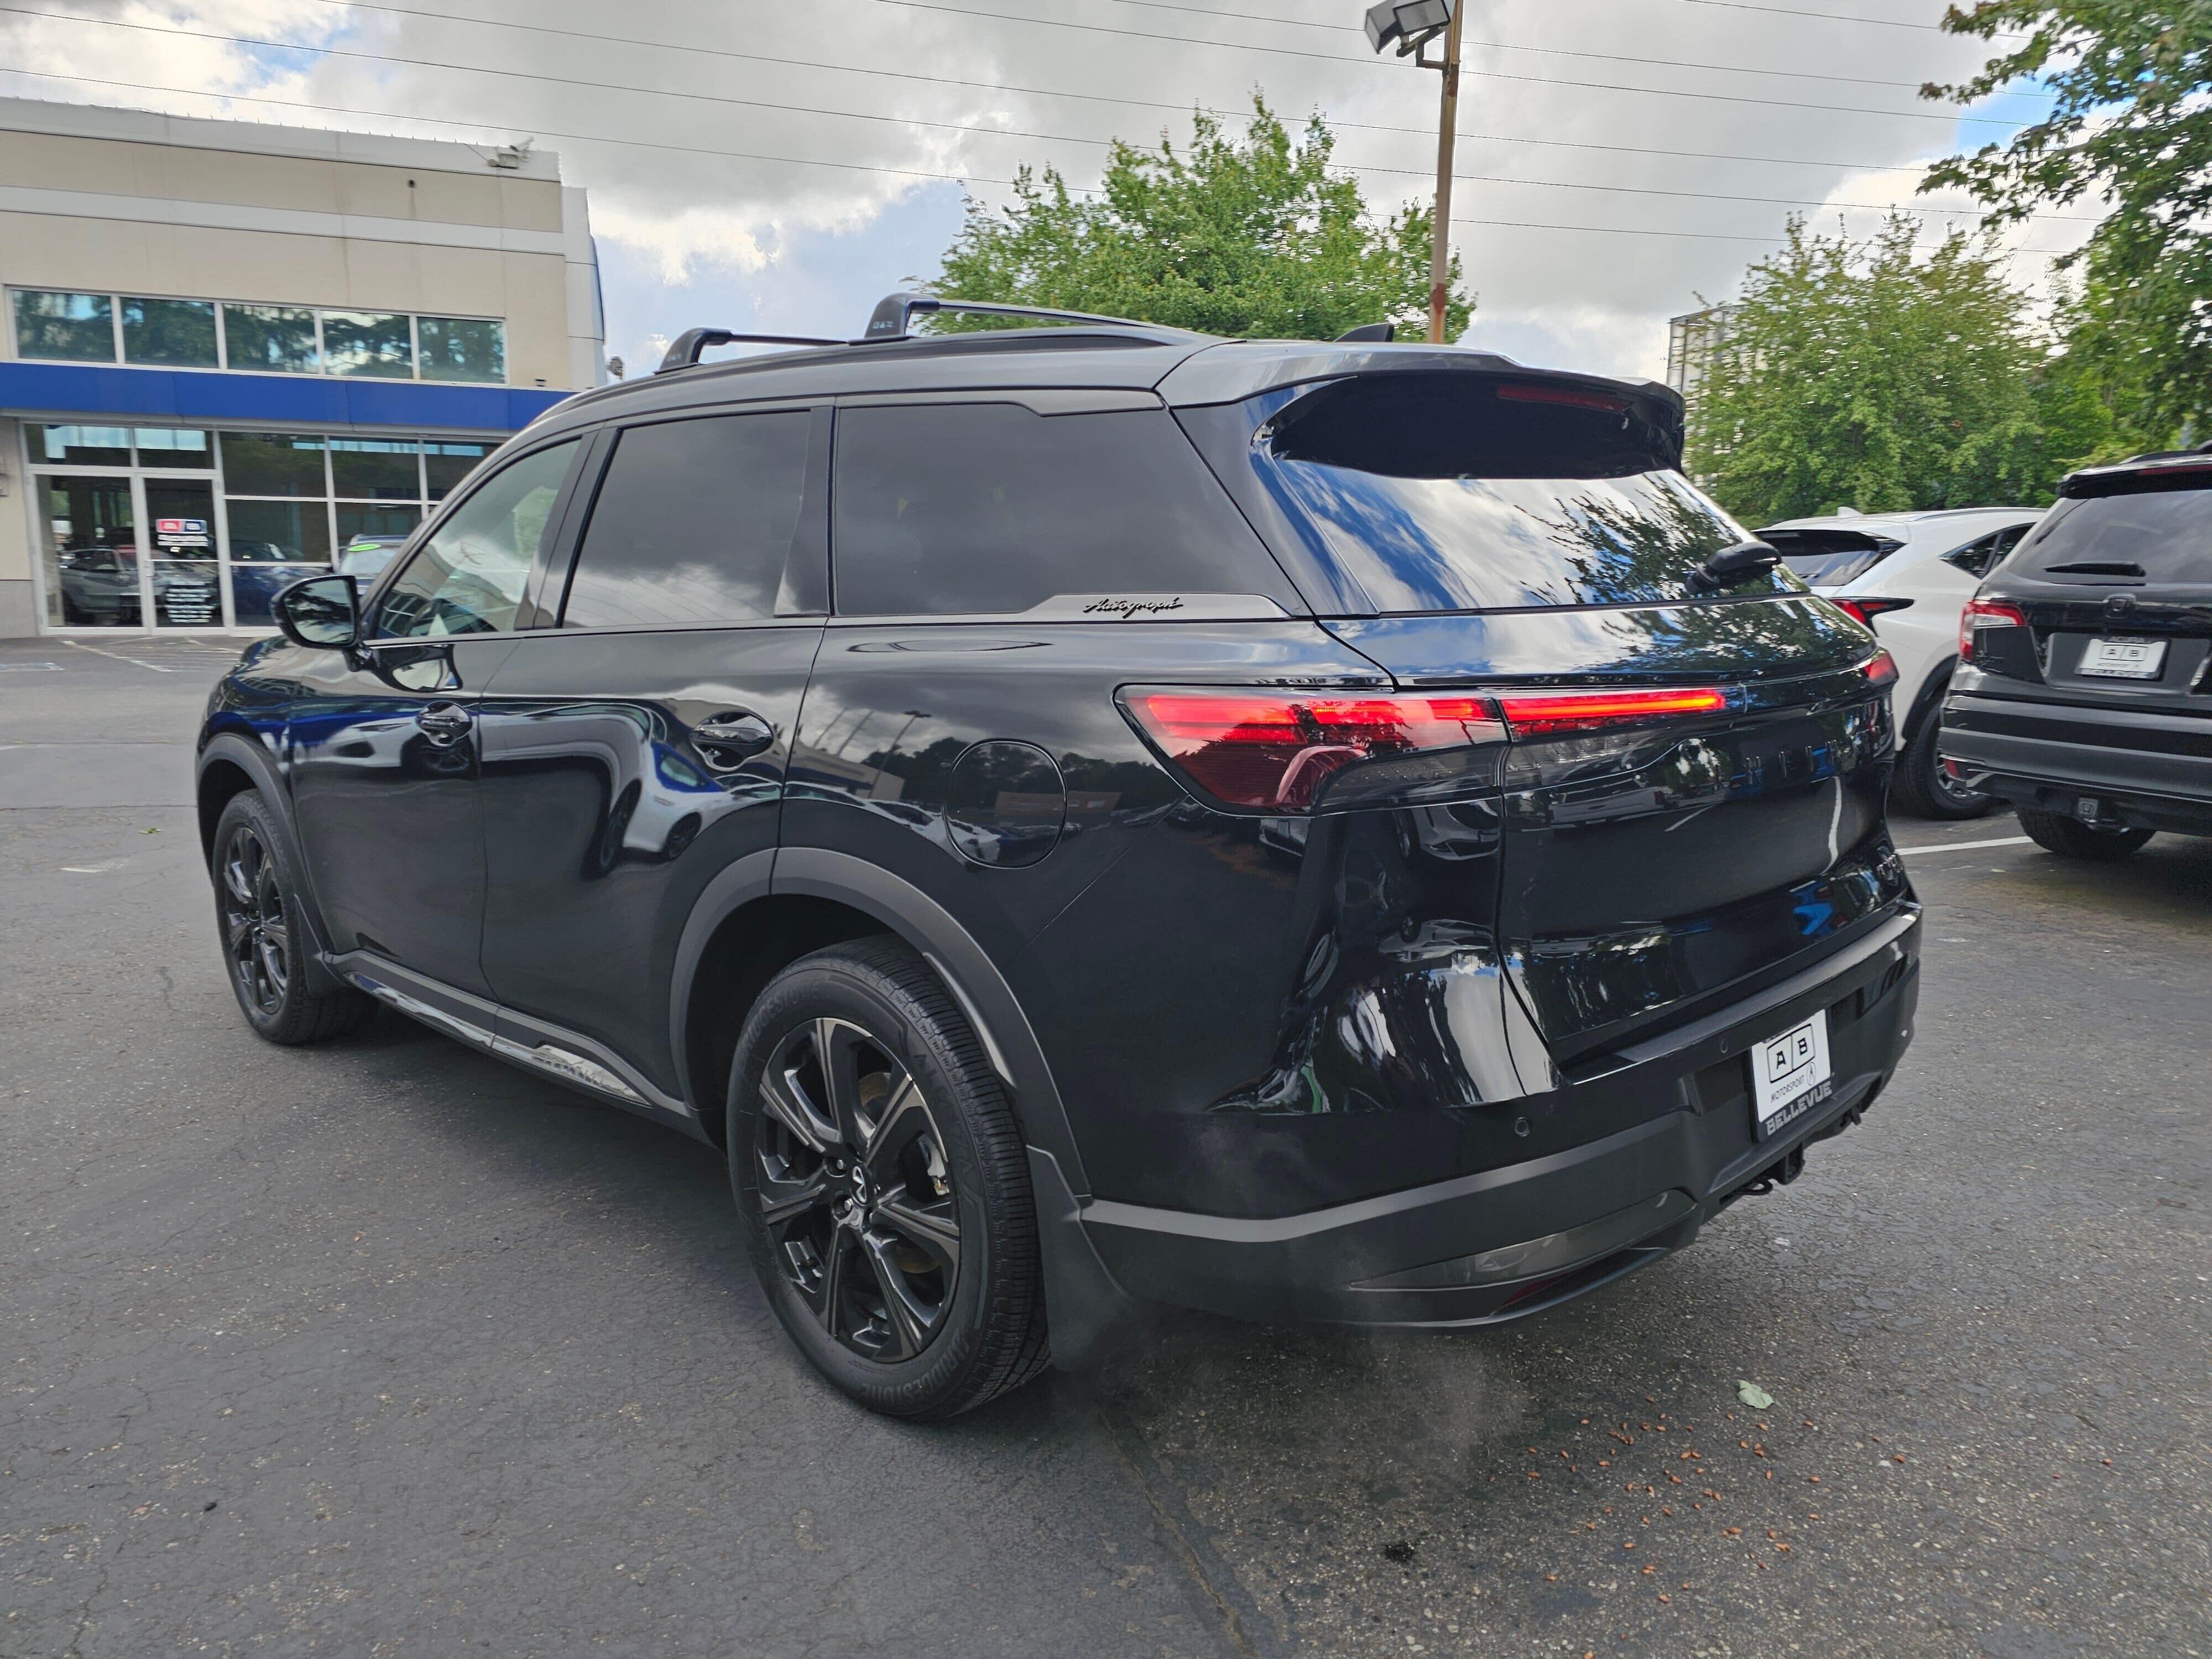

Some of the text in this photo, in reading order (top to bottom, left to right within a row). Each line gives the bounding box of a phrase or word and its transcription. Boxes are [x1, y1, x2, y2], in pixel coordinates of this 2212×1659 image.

[1082, 597, 1185, 620] Autograph
[1776, 1037, 1808, 1070] A B
[1765, 1080, 1833, 1136] BELLEVUE
